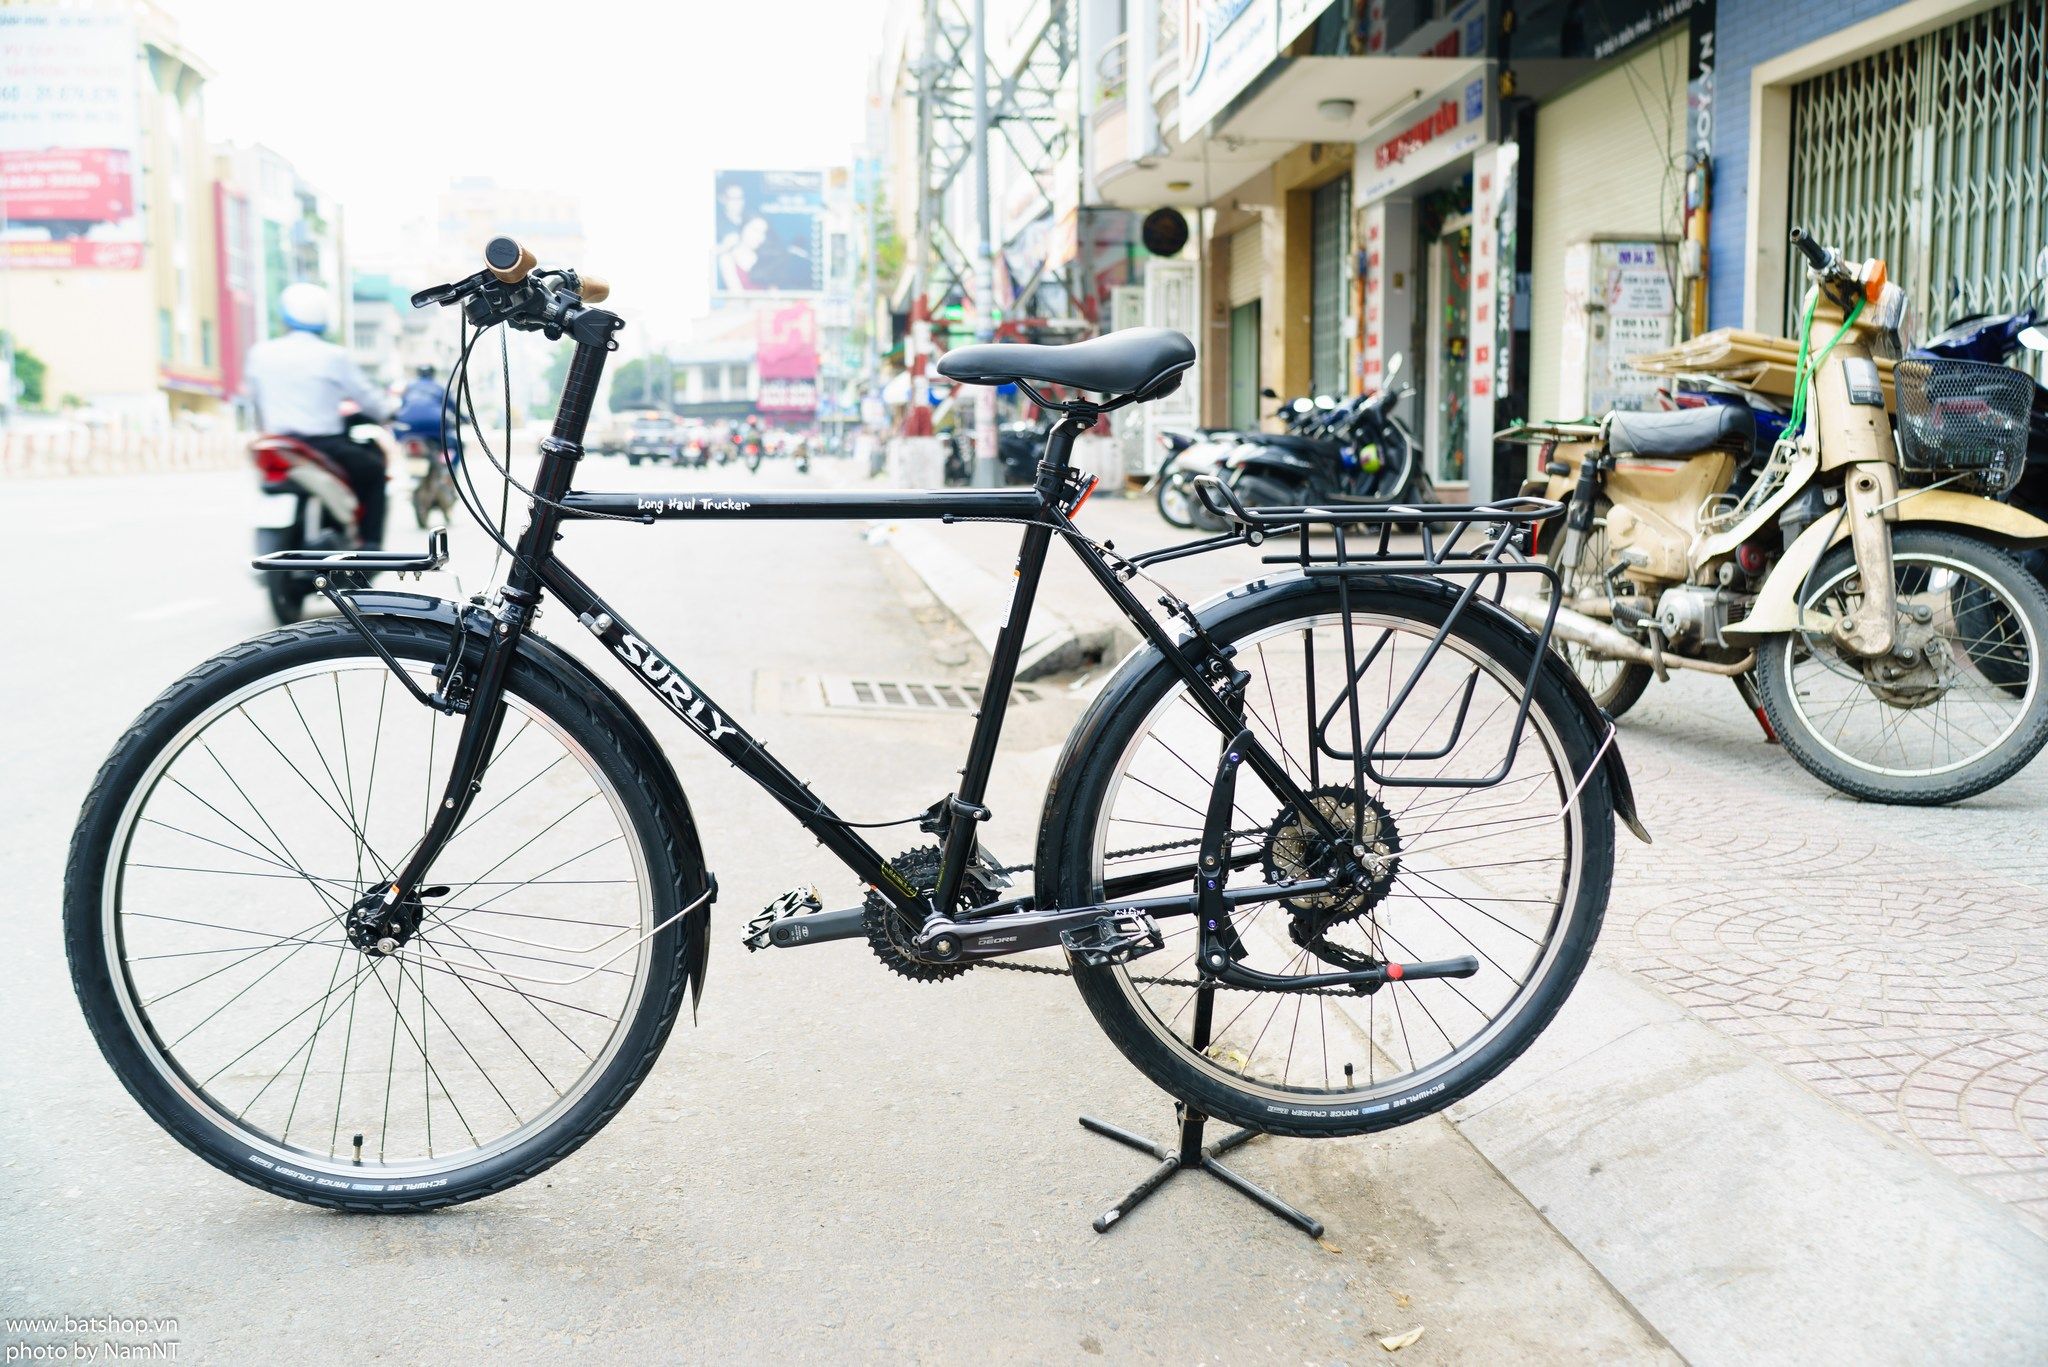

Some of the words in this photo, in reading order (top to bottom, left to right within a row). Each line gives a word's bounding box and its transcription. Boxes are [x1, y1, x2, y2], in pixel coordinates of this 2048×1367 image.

[637, 497, 664, 514] Long
[668, 497, 696, 511] Haul
[699, 498, 751, 511] Trucker
[614, 634, 738, 740] SURLY
[978, 935, 1018, 945] DEORE
[1392, 1082, 1446, 1108] SCHWALBE
[1291, 1108, 1327, 1117] CRUISER
[1330, 1108, 1359, 1117] RANGE
[274, 1165, 315, 1182] CRUISER
[316, 1178, 350, 1189] RANGE
[387, 1178, 448, 1192] SCHWALBE
